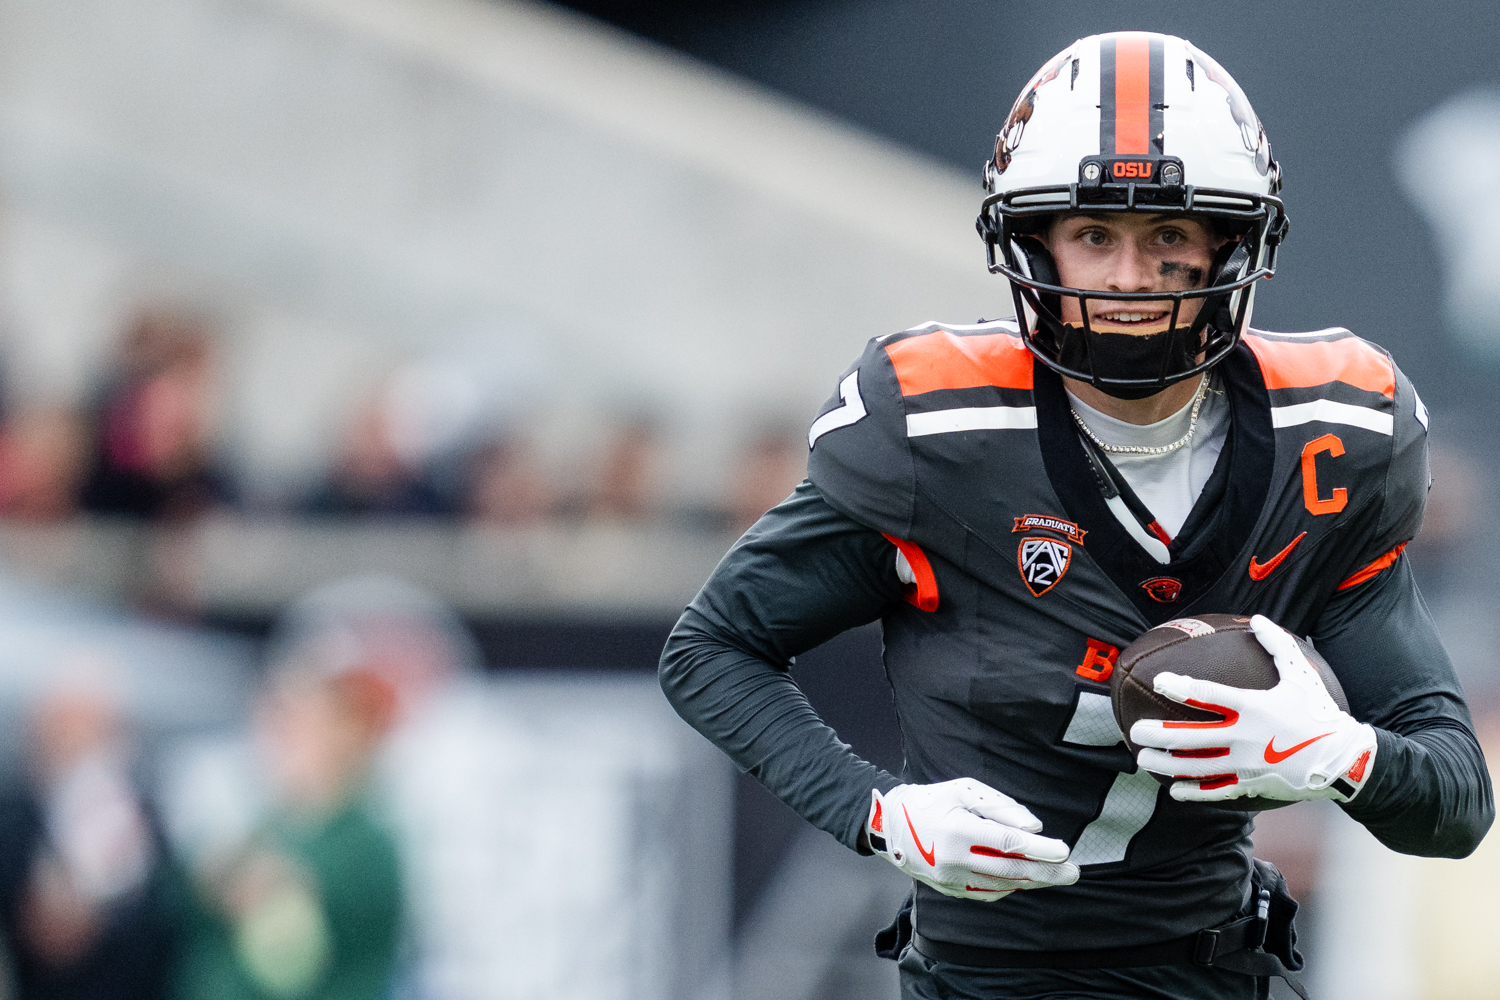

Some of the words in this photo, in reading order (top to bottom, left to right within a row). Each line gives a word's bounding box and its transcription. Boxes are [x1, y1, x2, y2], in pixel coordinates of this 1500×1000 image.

[1113, 161, 1152, 178] OSU
[808, 368, 867, 449] 7
[1301, 433, 1348, 516] C
[1024, 517, 1076, 535] GRADUATE
[1021, 540, 1069, 578] PAC
[1028, 562, 1053, 586] 12
